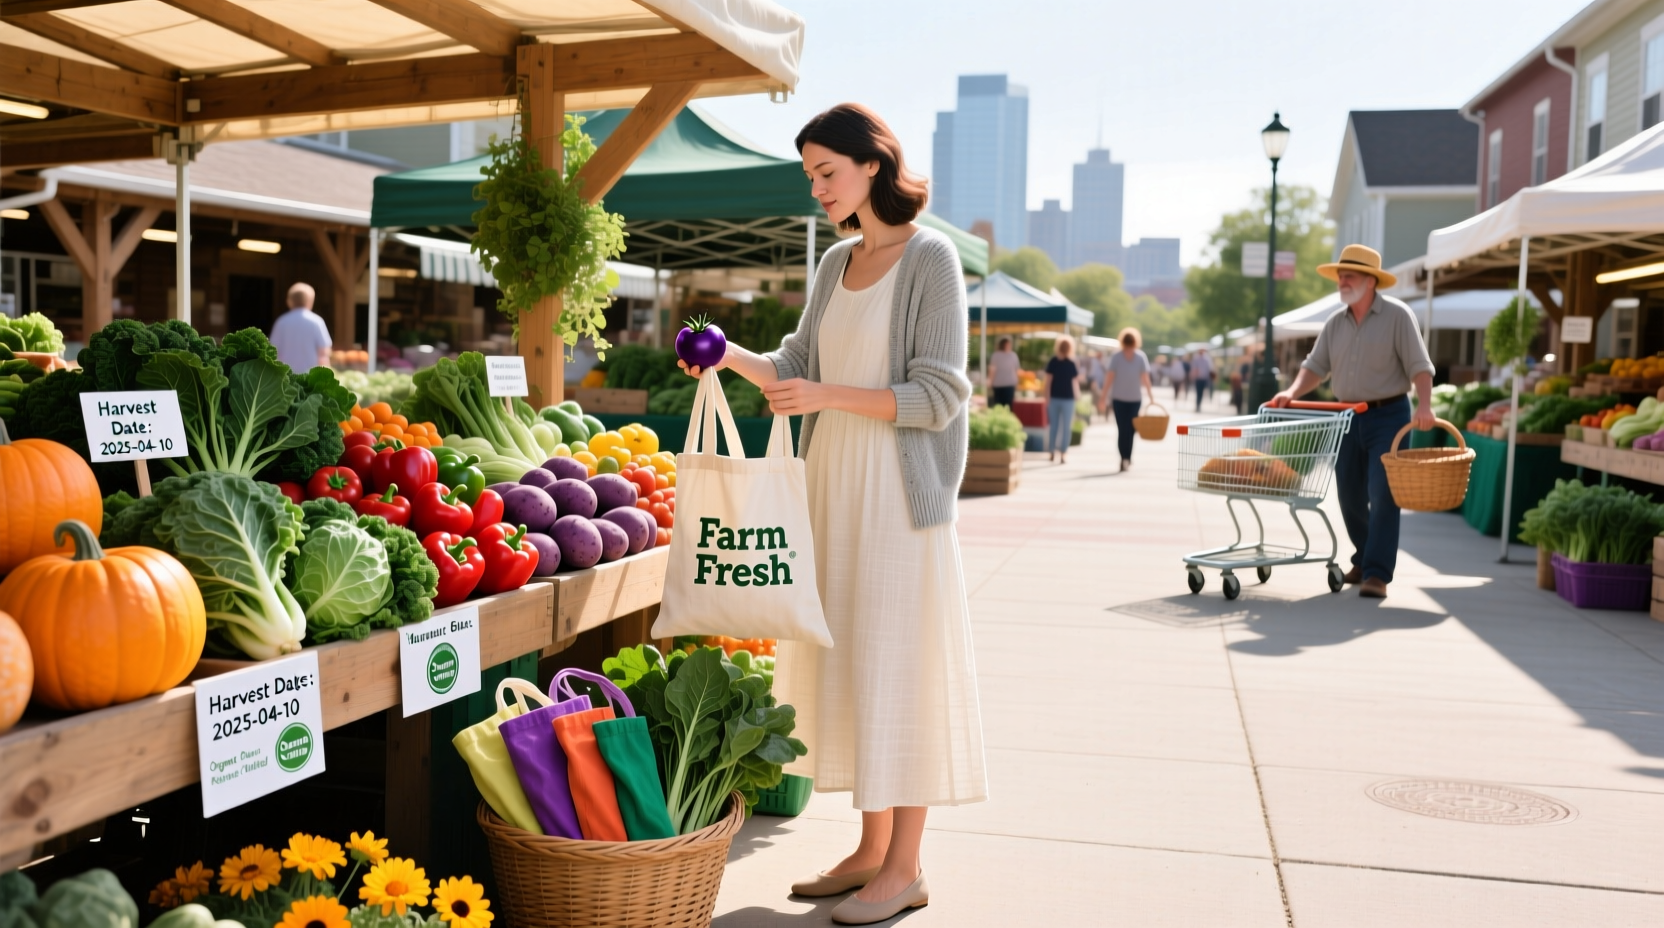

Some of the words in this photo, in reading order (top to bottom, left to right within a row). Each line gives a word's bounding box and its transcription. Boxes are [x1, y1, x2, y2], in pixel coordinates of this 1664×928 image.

[98, 400, 157, 417] Harvest
[111, 421, 152, 436] Date:
[697, 517, 788, 550] Farm
[694, 553, 793, 587] Fresh
[209, 683, 270, 715] Harvest
[212, 698, 300, 741] 2025-04-10
